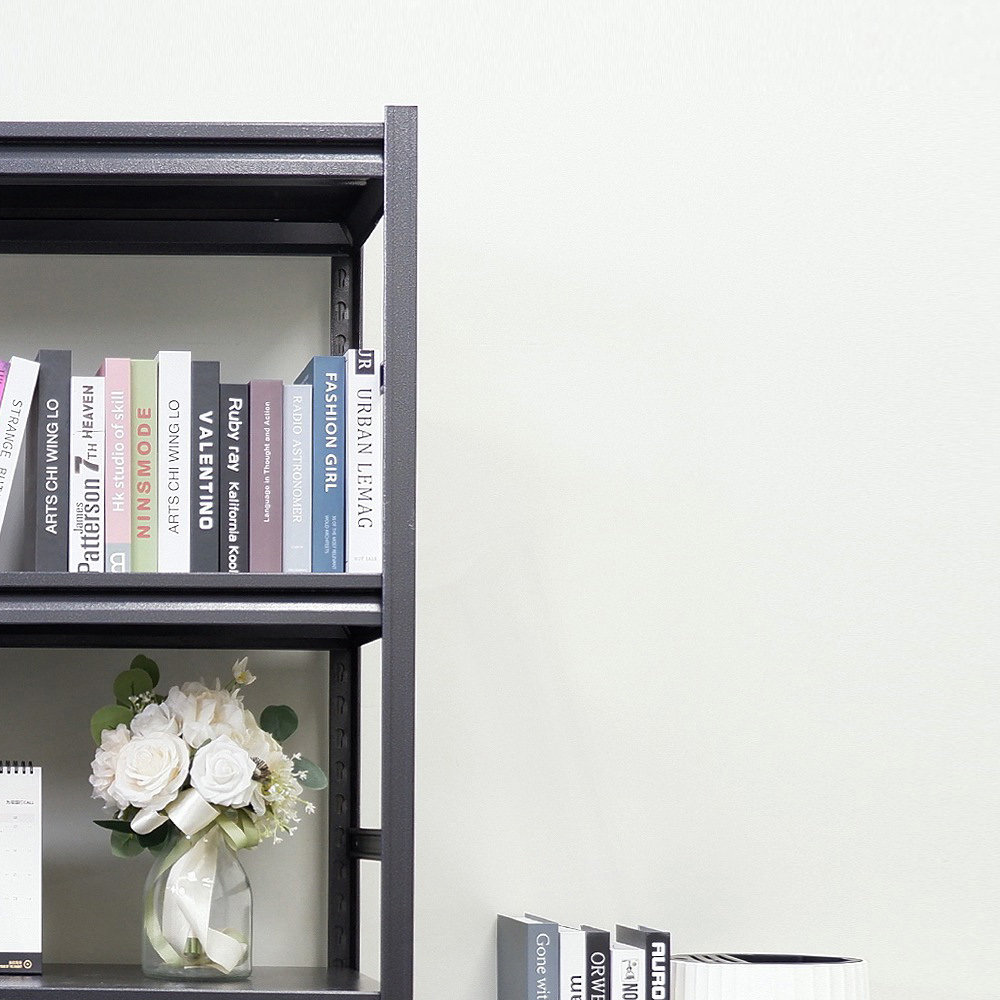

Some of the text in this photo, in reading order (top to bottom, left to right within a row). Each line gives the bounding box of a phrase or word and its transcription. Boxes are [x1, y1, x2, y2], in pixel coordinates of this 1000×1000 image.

[0, 399, 23, 458] STRANGE
[45, 399, 59, 534] ARTS CHI WING LO
[82, 385, 94, 439] HEAVEN
[111, 391, 124, 512] Hk studio of skill
[168, 399, 180, 534] ARTS CHI WING LO
[199, 411, 213, 530] VALENTINO
[227, 397, 242, 441] Ruby
[227, 445, 239, 472] ray
[263, 401, 271, 522] Language in Thought and Action
[292, 396, 303, 524] RADIO ASTRONOMER
[325, 373, 337, 492] FASHION GIRL
[357, 389, 372, 528] URBAN LEMAG
[73, 502, 84, 534] James
[137, 408, 152, 539] NINSMODE
[228, 481, 240, 542] Kalifornia
[536, 933, 550, 974] Gone
